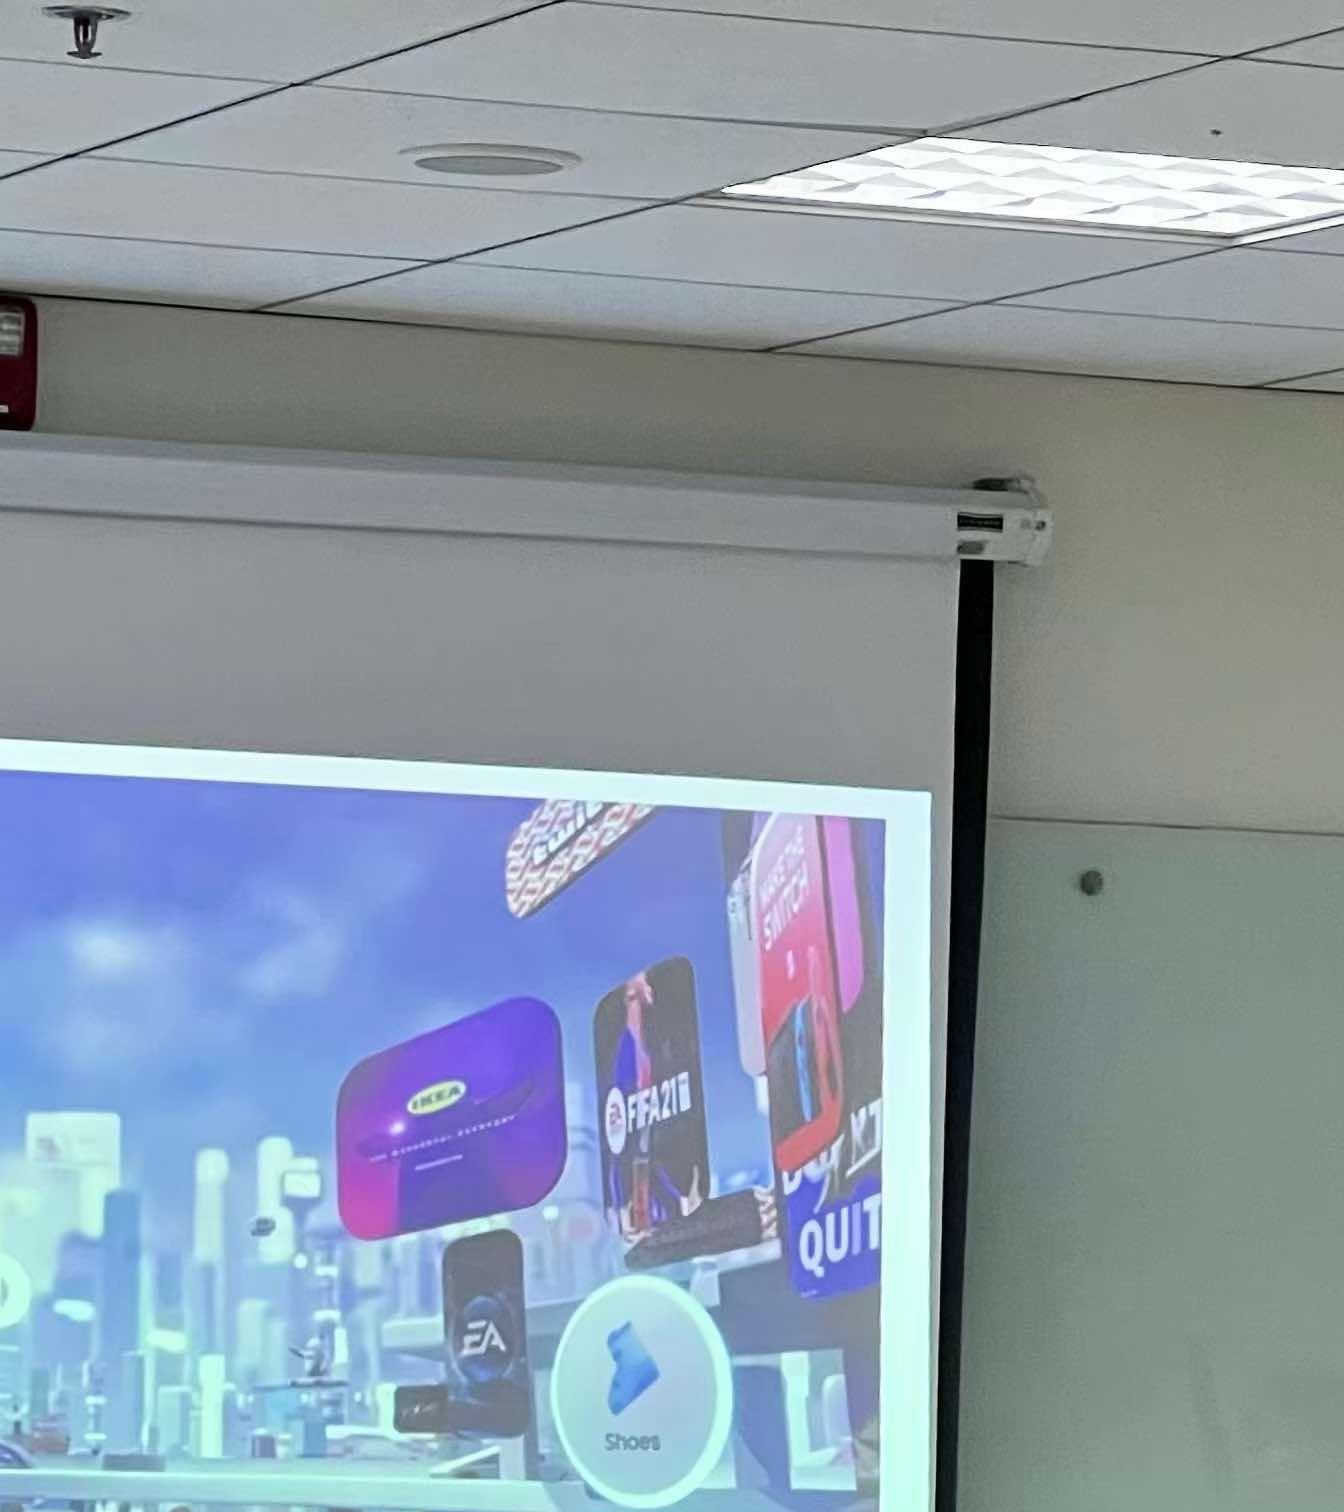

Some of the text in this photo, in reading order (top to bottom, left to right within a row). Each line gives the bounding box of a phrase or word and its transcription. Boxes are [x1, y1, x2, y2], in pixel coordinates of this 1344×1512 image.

[412, 1084, 462, 1110] IKEA
[460, 1320, 507, 1356] EA
[605, 1433, 661, 1452] Shoes
